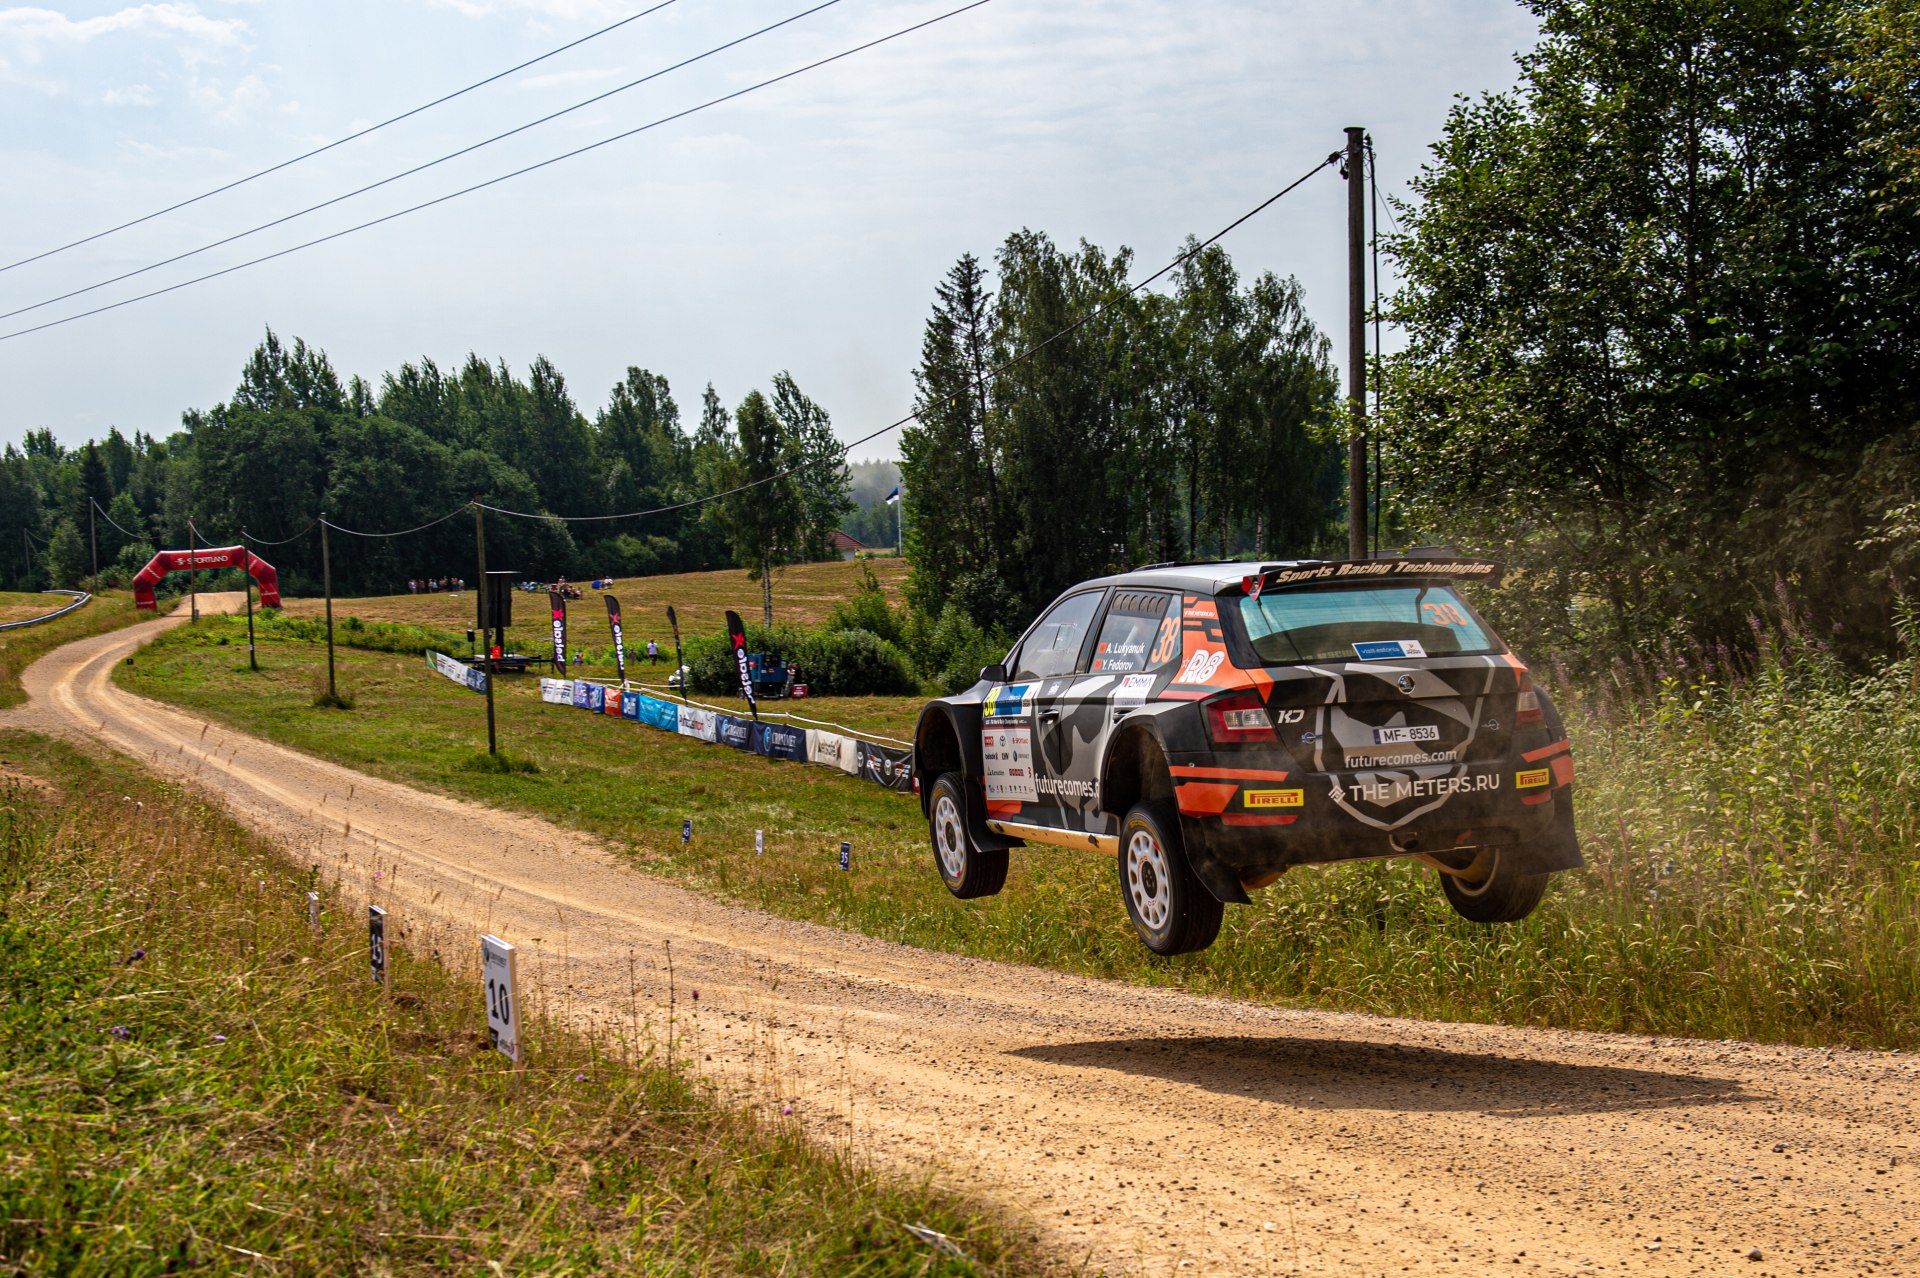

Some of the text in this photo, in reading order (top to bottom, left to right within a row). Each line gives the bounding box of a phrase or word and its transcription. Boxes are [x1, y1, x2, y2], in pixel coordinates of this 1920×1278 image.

[1276, 561, 1495, 583] Sports Racing Technologies
[1423, 602, 1467, 626] 38
[1151, 616, 1182, 663] 38
[1106, 642, 1145, 656] A. Lukyanuk
[1102, 659, 1134, 670] Y. Fedorov
[1410, 728, 1436, 740] 8536
[1345, 750, 1457, 768] futurecomes.com
[1520, 771, 1548, 786] PIRELLI
[1349, 774, 1500, 802] THE METERS.RU
[1250, 793, 1298, 805] PIRELLI
[840, 851, 849, 863] 35
[371, 933, 382, 964] 15
[488, 978, 509, 1025] 10
